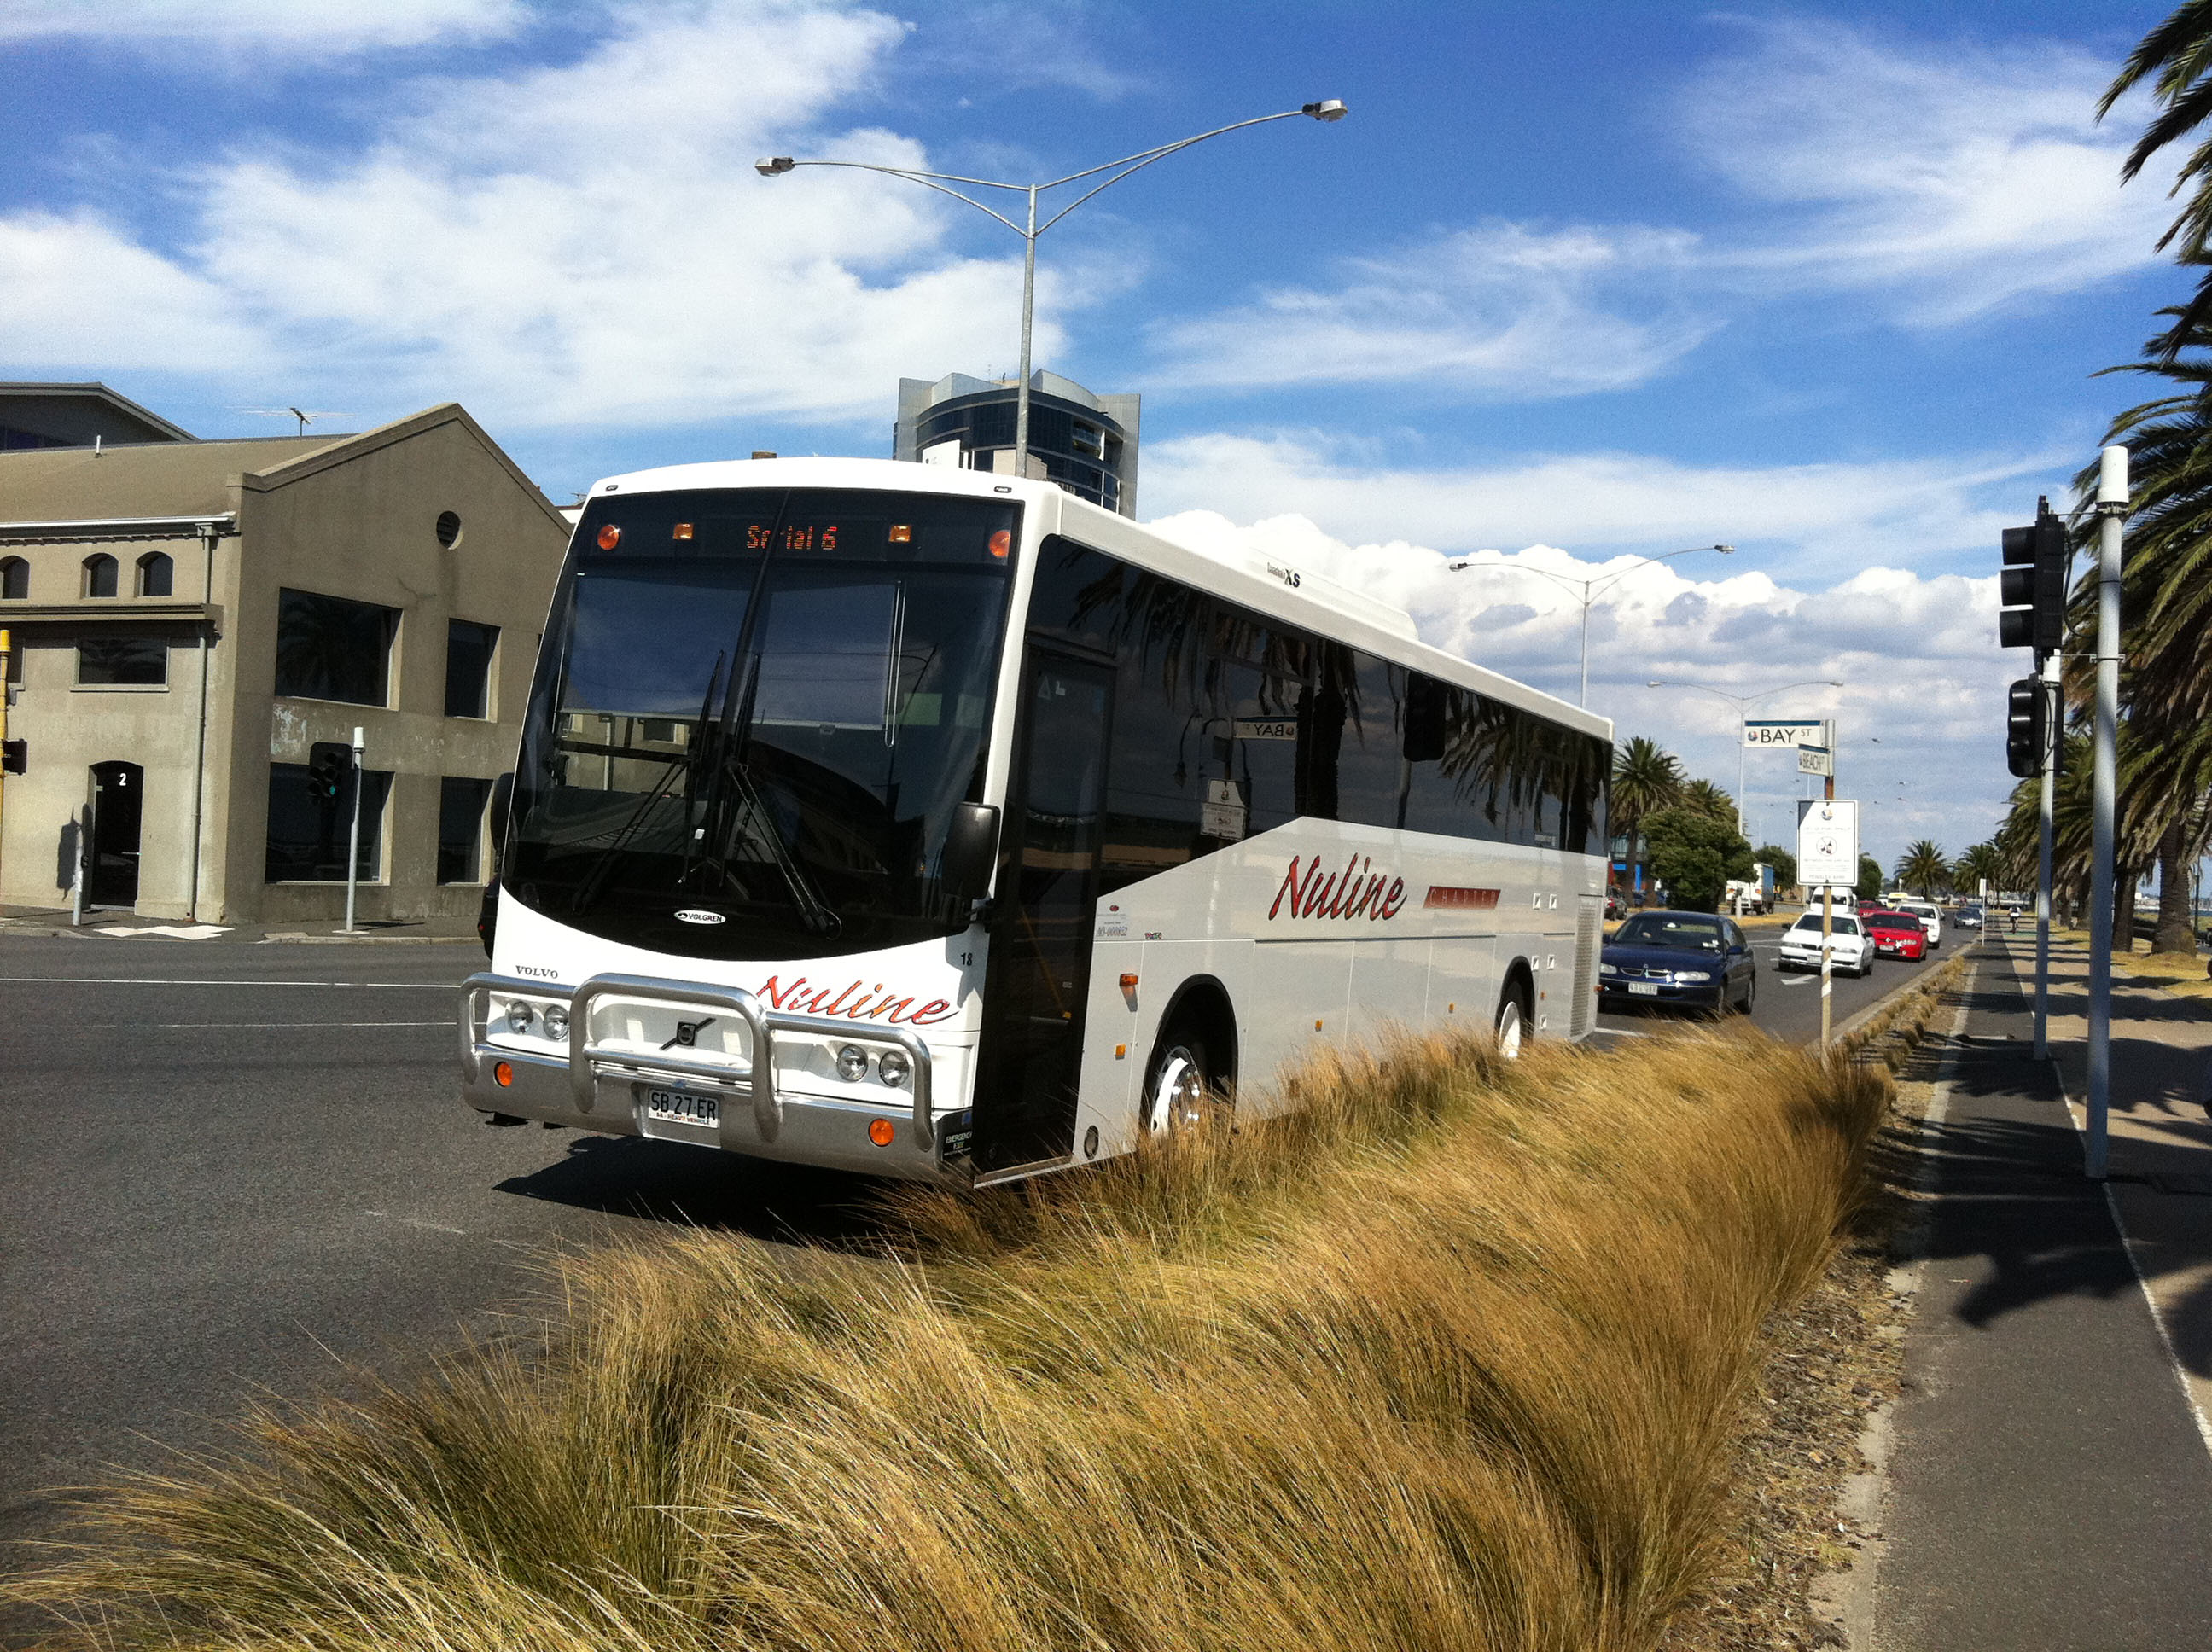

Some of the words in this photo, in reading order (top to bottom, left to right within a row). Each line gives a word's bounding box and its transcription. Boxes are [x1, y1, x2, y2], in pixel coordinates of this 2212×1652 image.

[747, 525, 813, 550] Seial
[821, 526, 838, 550] 6
[1284, 567, 1301, 588] XS
[1761, 728, 1796, 744] BAY
[1800, 728, 1812, 737] ST
[119, 772, 127, 786] 2
[1268, 852, 1408, 922] Nuline
[688, 912, 723, 922] VOLGREN
[960, 952, 973, 967] 18
[515, 964, 558, 980] VOLVO
[756, 975, 960, 1025] Nuline
